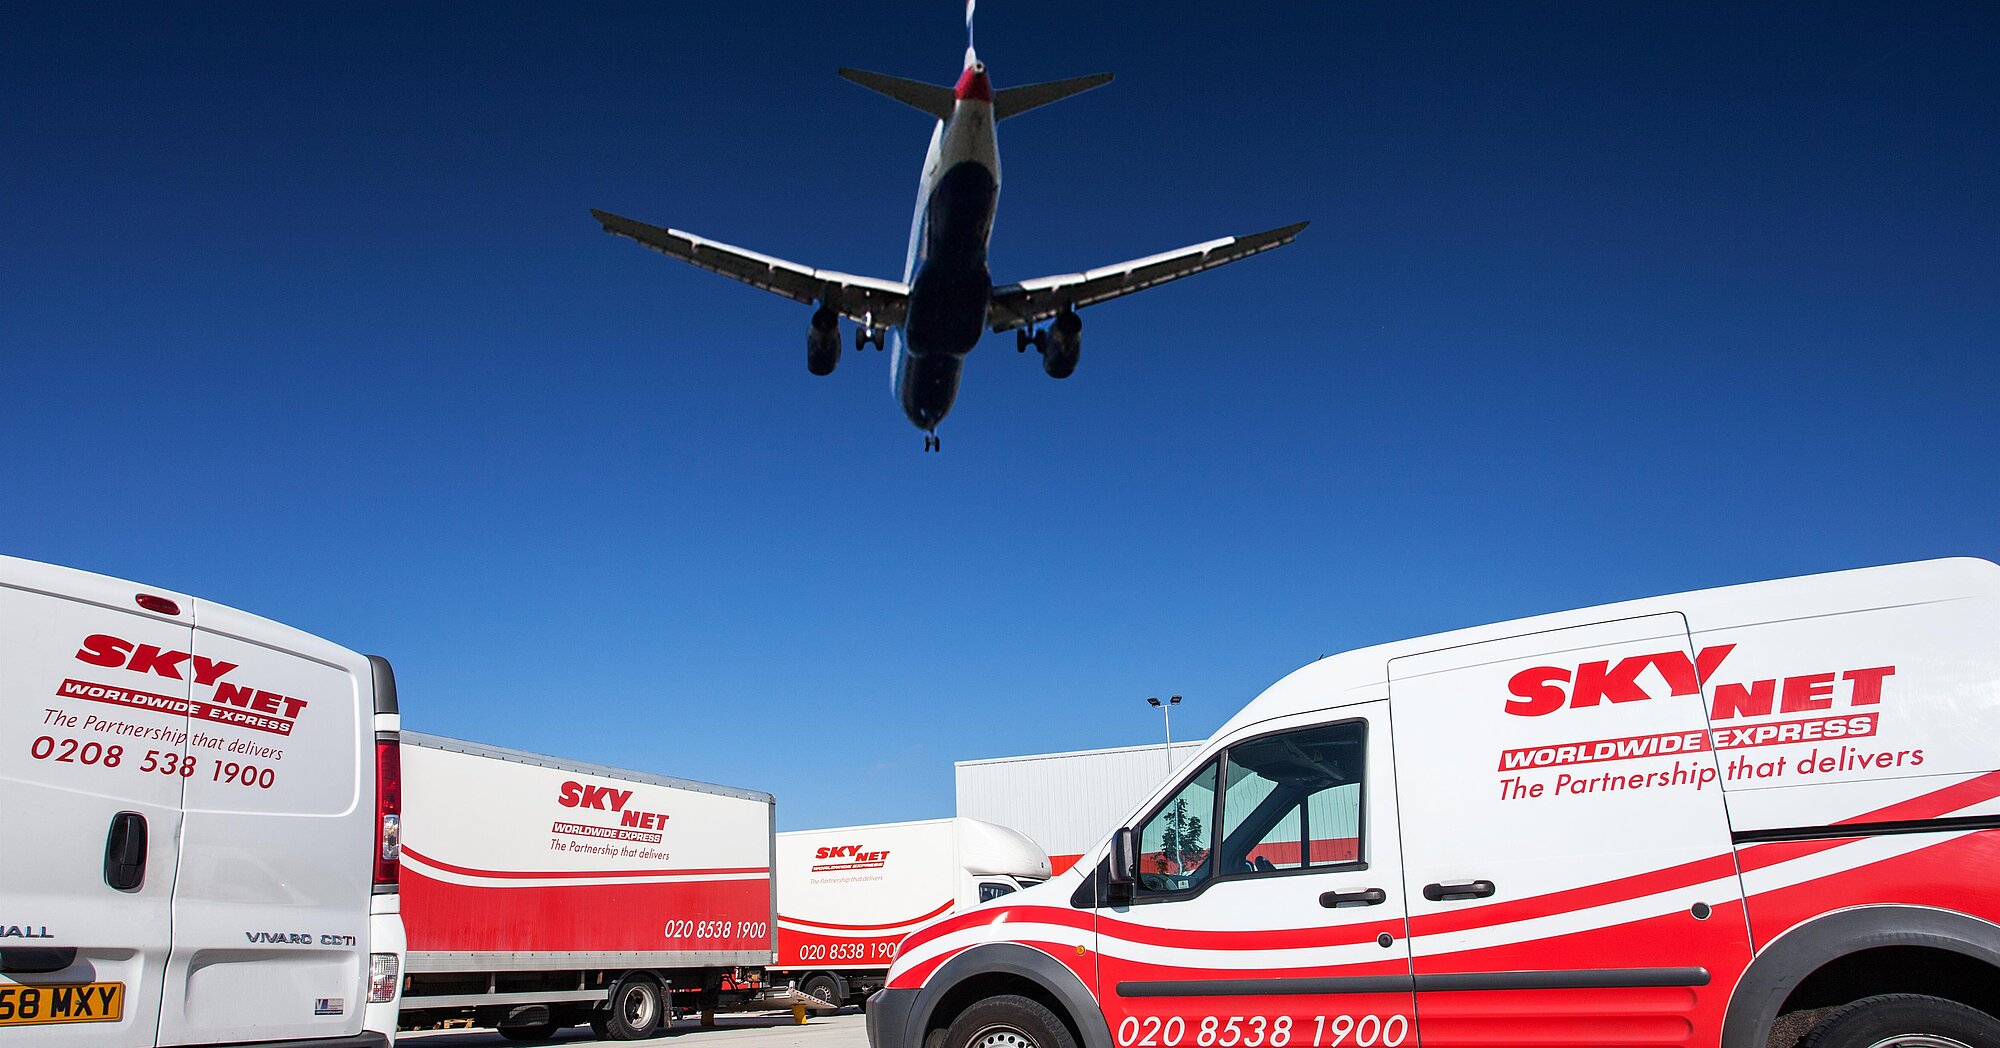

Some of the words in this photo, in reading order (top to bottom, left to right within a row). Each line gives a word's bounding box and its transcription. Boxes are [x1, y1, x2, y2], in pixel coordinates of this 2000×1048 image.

[75, 634, 239, 686] SKY
[212, 682, 308, 719] NET
[1504, 643, 1737, 717] SKY
[1710, 666, 1896, 720] NET
[65, 682, 201, 714] WORLDWIDE
[209, 709, 291, 732] EXPRESS
[43, 708, 78, 728] The
[83, 715, 187, 745] Partnership
[192, 733, 223, 750] that
[227, 738, 284, 761] delivers
[1504, 733, 1703, 769] WORLDWIDE
[1713, 716, 1872, 749] EXPRESS
[31, 736, 124, 768] 0208
[140, 750, 197, 778] 538
[213, 760, 276, 789] 1900
[1499, 779, 1544, 800] The
[1555, 761, 1716, 796] Partnership
[1727, 755, 1786, 781] that
[1797, 746, 1925, 774] delivers
[558, 780, 633, 812] SKY
[620, 810, 670, 831] NET
[551, 838, 567, 851] The
[569, 841, 618, 859] Partnership
[621, 846, 637, 858] that
[639, 848, 670, 861] delivers
[554, 822, 617, 839] WORLDWIDE
[618, 831, 661, 843] EXPRESS
[815, 845, 863, 859] SKY
[855, 851, 890, 861] NET
[246, 932, 312, 945] VIVARO
[320, 934, 356, 946] CDTI
[664, 920, 694, 938] 020
[696, 920, 731, 938] 8538
[736, 921, 767, 938] 1900
[799, 944, 826, 960] 020
[829, 943, 864, 959] 8538
[50, 987, 117, 1017] MXY
[1117, 1016, 1186, 1047] 020
[1196, 1015, 1293, 1047] 8538
[1313, 1014, 1409, 1047] 1900
